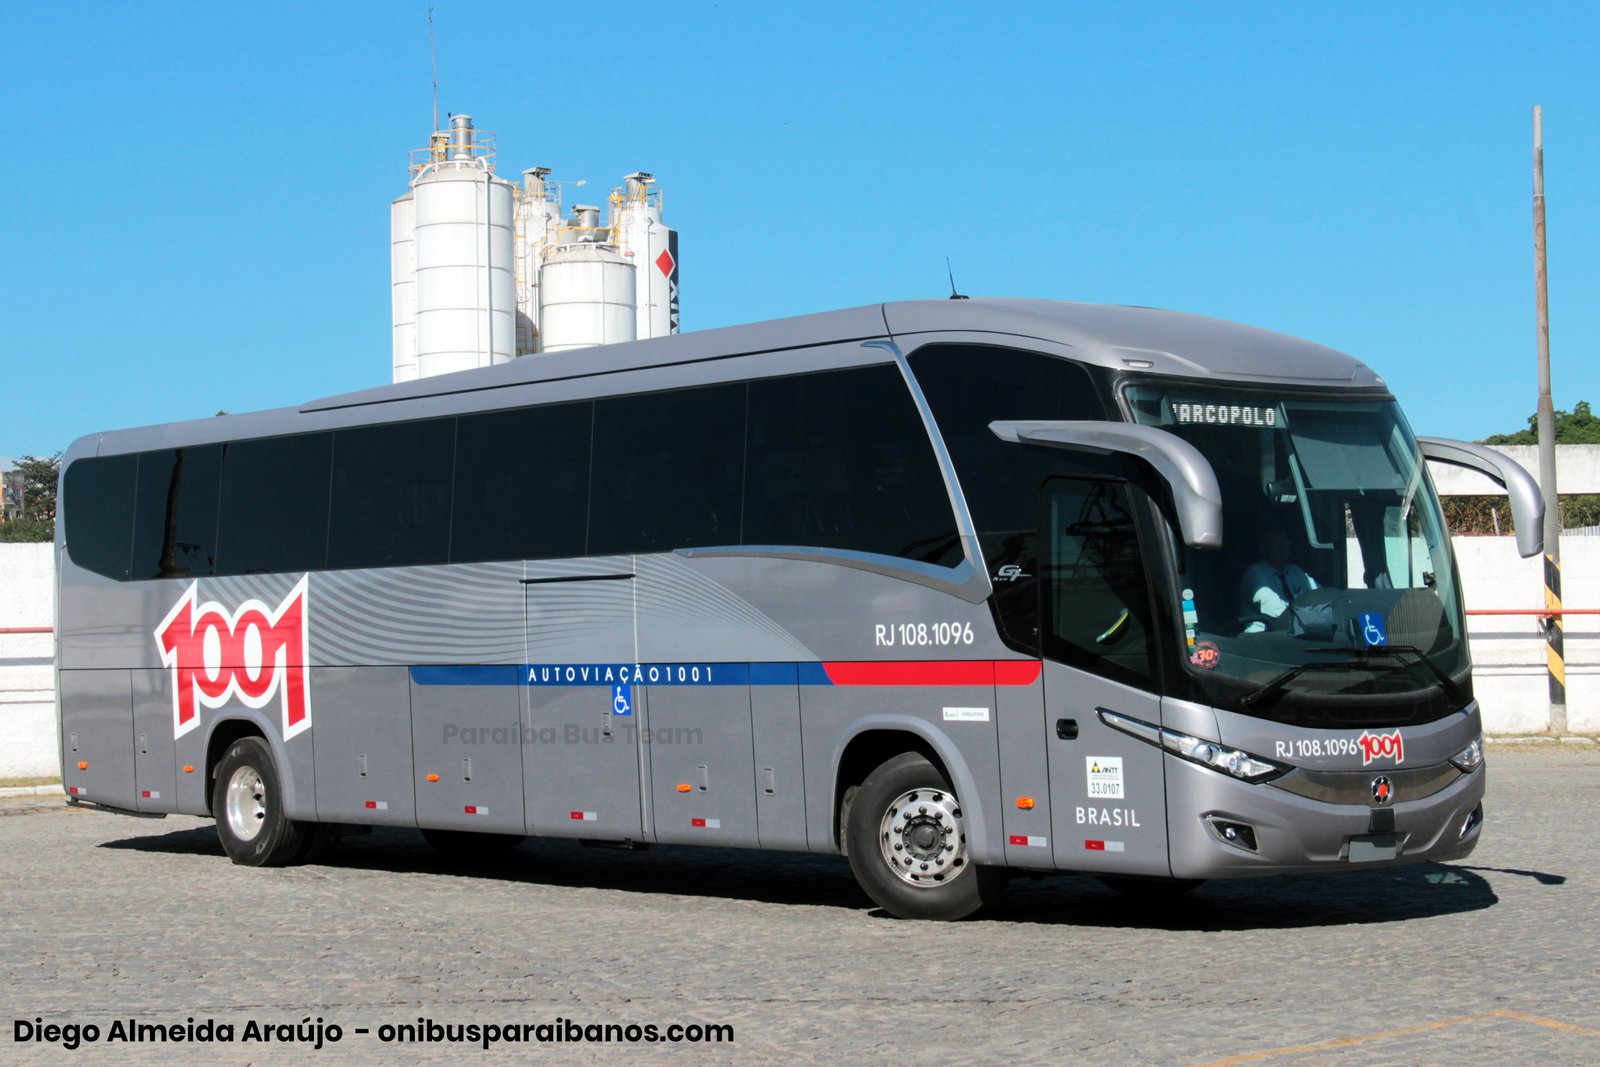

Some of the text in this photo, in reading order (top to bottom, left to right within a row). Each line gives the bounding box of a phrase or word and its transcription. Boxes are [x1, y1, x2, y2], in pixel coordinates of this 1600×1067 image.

[1172, 404, 1275, 425] ARCOPOLO
[875, 621, 975, 646] RJ 108.1096
[154, 571, 312, 742] 1001
[1275, 738, 1358, 758] RJ 108.1096
[1357, 728, 1405, 767] 1001
[1101, 766, 1119, 774] ANTT
[1091, 782, 1120, 795] 33.0107
[1075, 806, 1141, 827] BRASIL
